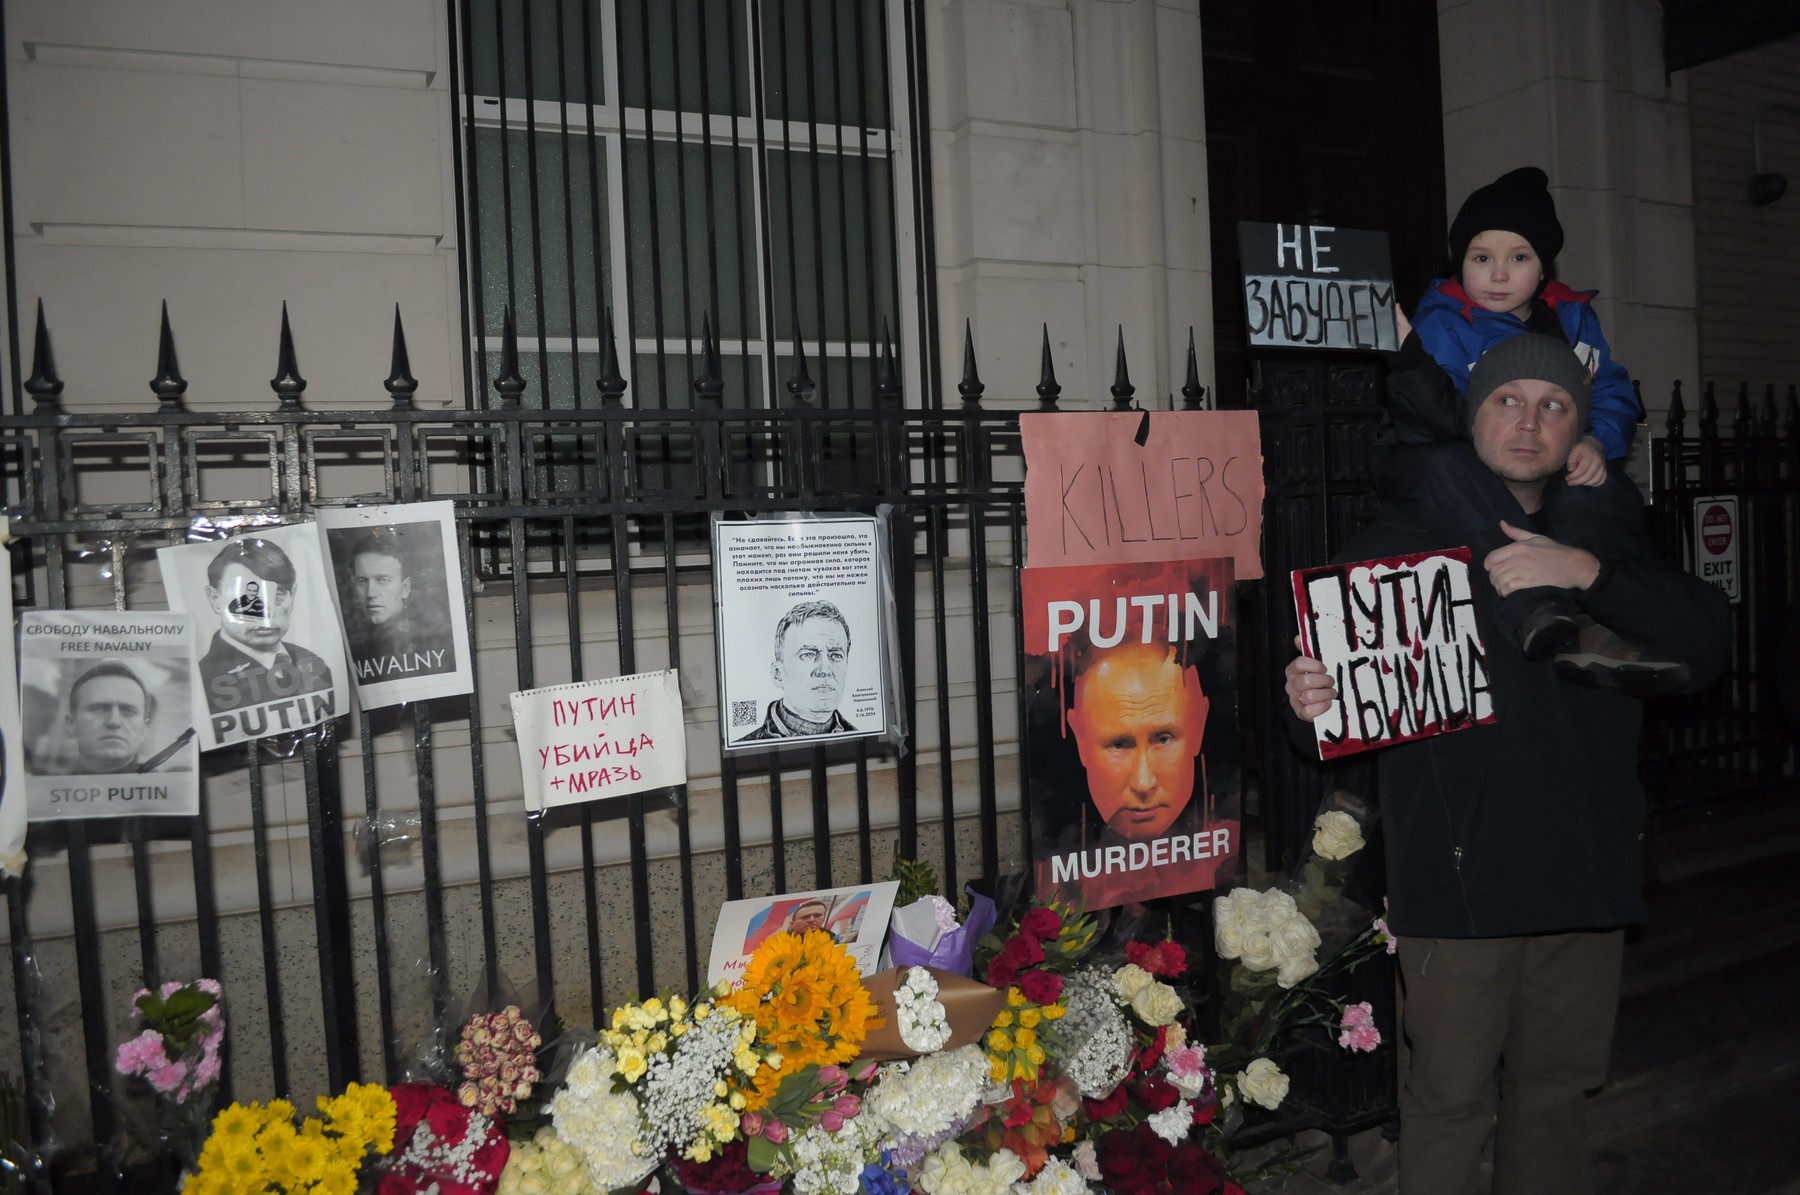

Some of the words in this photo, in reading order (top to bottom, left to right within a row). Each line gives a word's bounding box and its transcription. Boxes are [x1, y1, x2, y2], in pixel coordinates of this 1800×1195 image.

[1277, 223, 1340, 273] НЕ
[1246, 279, 1400, 351] ЗАБУДЕМ
[1060, 456, 1248, 555] KILLERS
[1716, 513, 1728, 523] NOT
[1707, 536, 1727, 547] ENTER
[1703, 560, 1732, 577] EXIT
[1706, 578, 1733, 591] NLY
[26, 624, 90, 636] СВОБОДУ
[93, 624, 184, 635] НАВАЛЬНОМУ
[1047, 590, 1219, 652] PUTIN
[60, 641, 90, 652] FREE
[94, 641, 152, 652] NAVALNY
[211, 657, 326, 709] STOP
[211, 690, 335, 744] PUTIN
[553, 693, 636, 727] ПУТИН
[539, 733, 654, 769] УБИЙЦА
[50, 786, 103, 803] STOP
[107, 785, 168, 802] PUTIN
[1051, 828, 1231, 883] MURDERER
